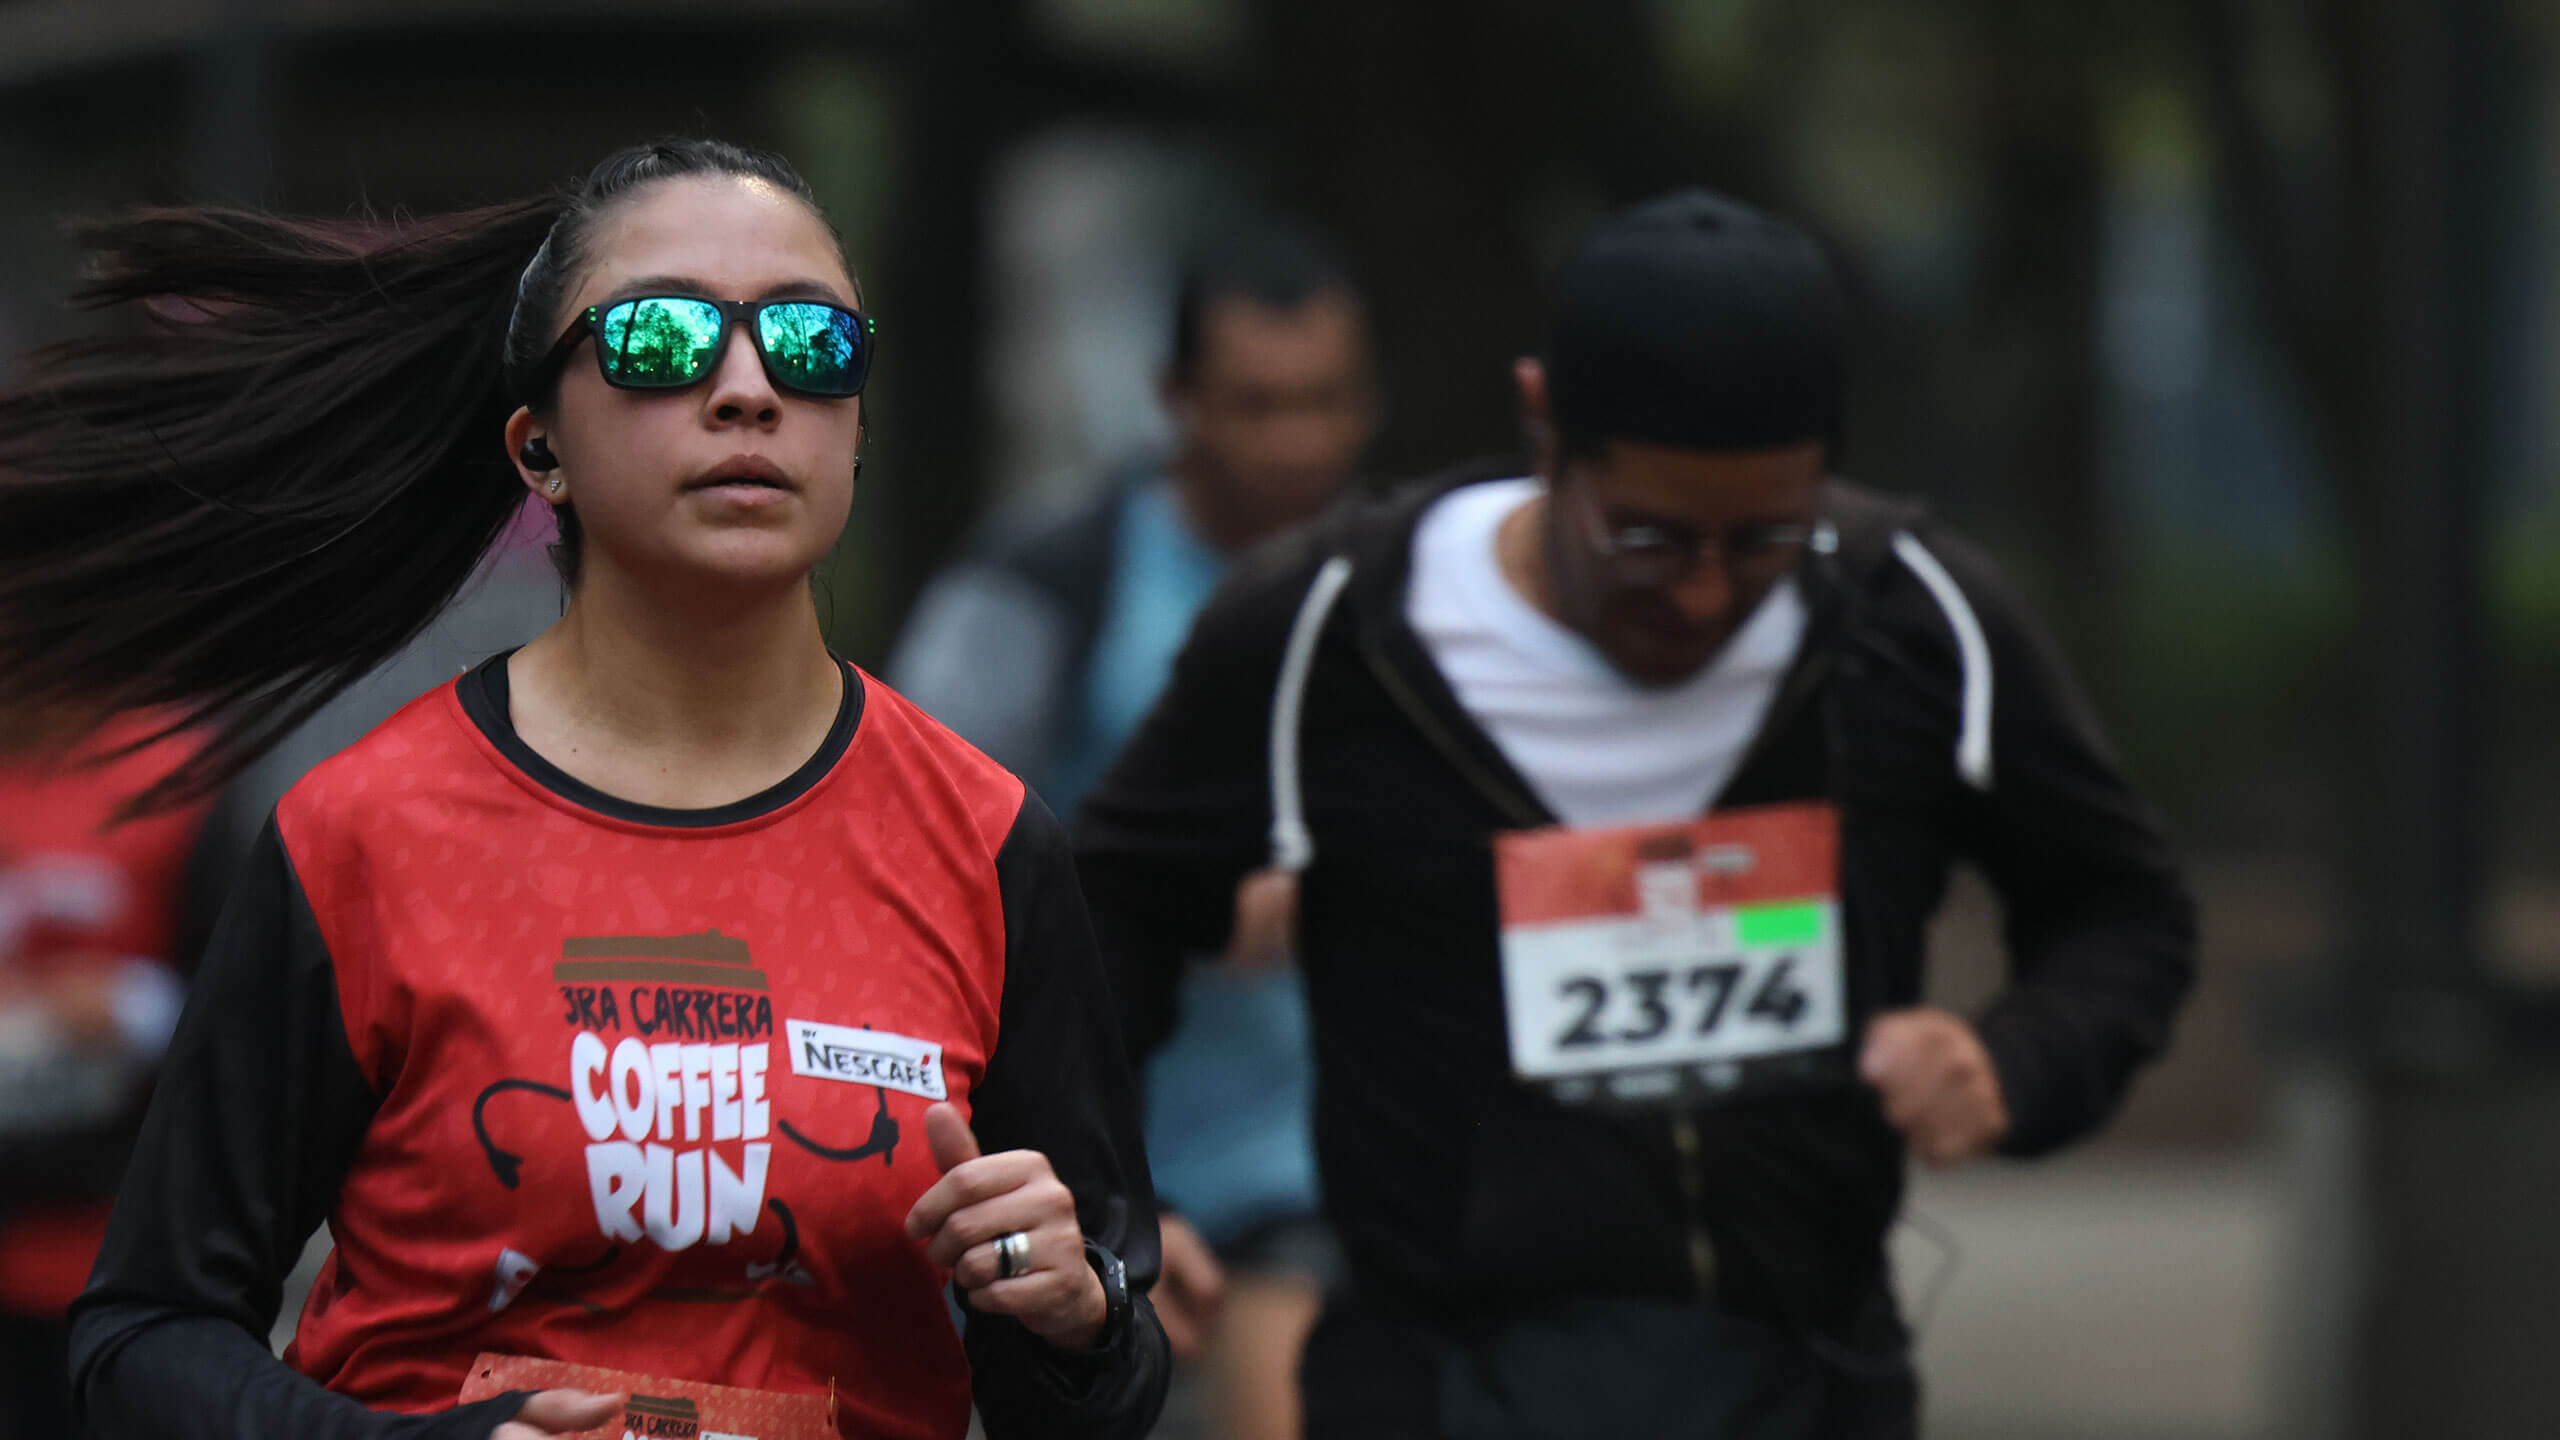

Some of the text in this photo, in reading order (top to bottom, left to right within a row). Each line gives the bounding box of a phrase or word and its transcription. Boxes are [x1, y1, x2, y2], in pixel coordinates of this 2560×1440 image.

[560, 986, 773, 1040] 3RA CARRERA
[1556, 956, 1810, 1048] 2374
[571, 1030, 770, 1142] COFFEE
[585, 1140, 771, 1251] RUN
